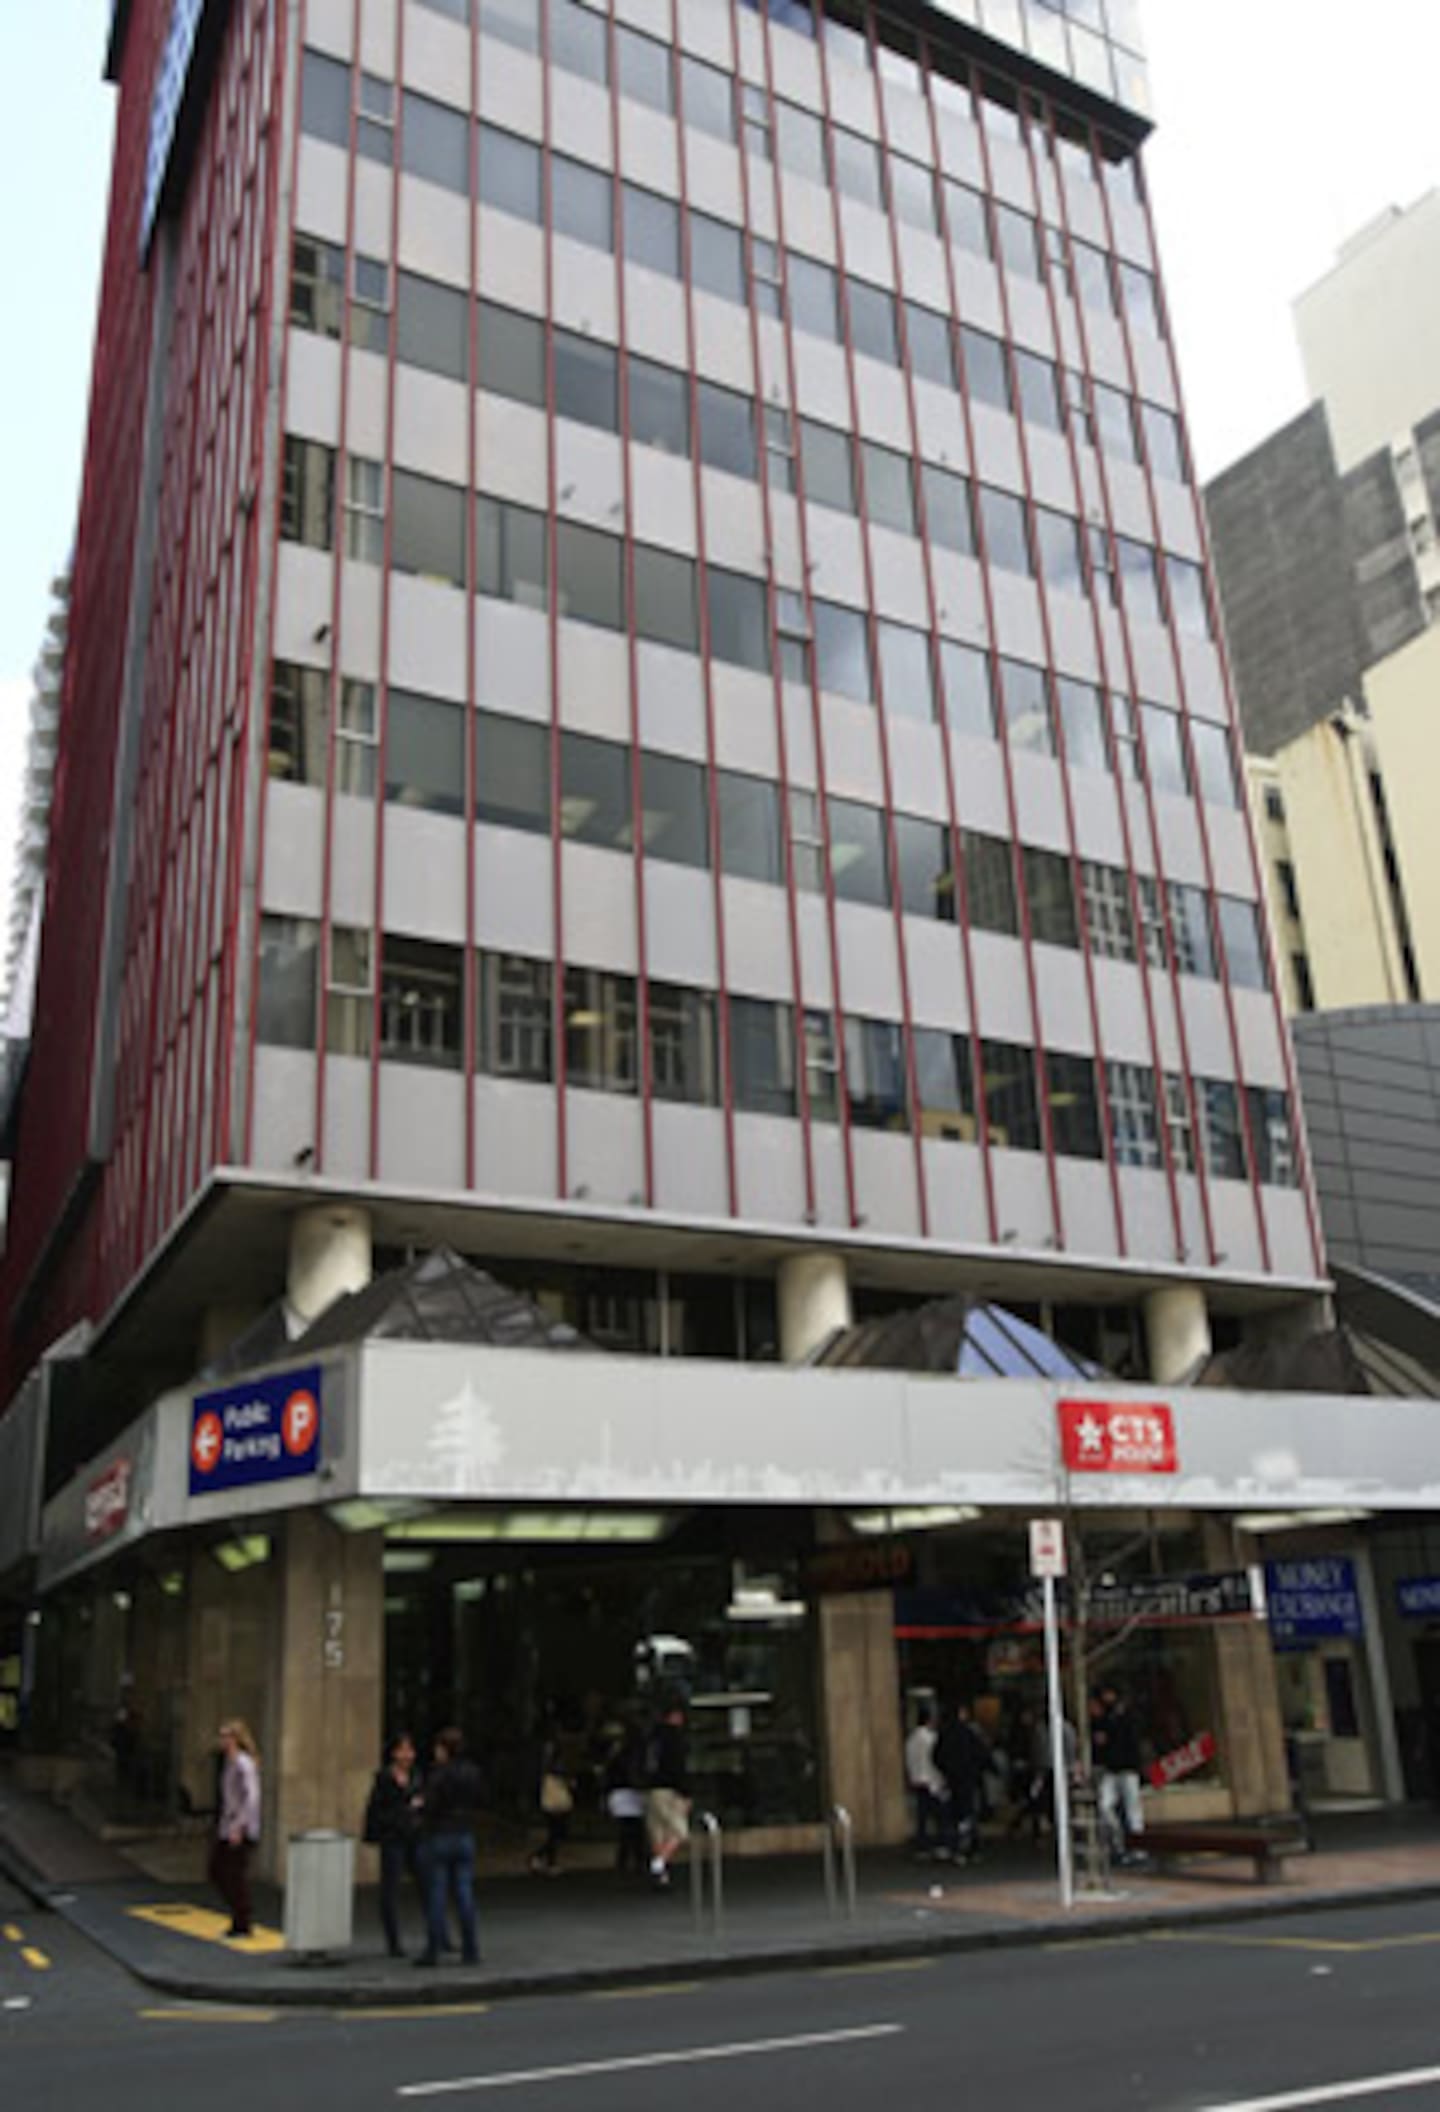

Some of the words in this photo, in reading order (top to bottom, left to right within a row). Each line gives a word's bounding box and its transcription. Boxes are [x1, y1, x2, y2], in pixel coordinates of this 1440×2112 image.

[223, 1401, 271, 1431] Public
[290, 1402, 312, 1442] P
[1107, 1414, 1164, 1442] CTS
[223, 1433, 281, 1462] Parking
[1160, 1738, 1206, 1781] SALE
